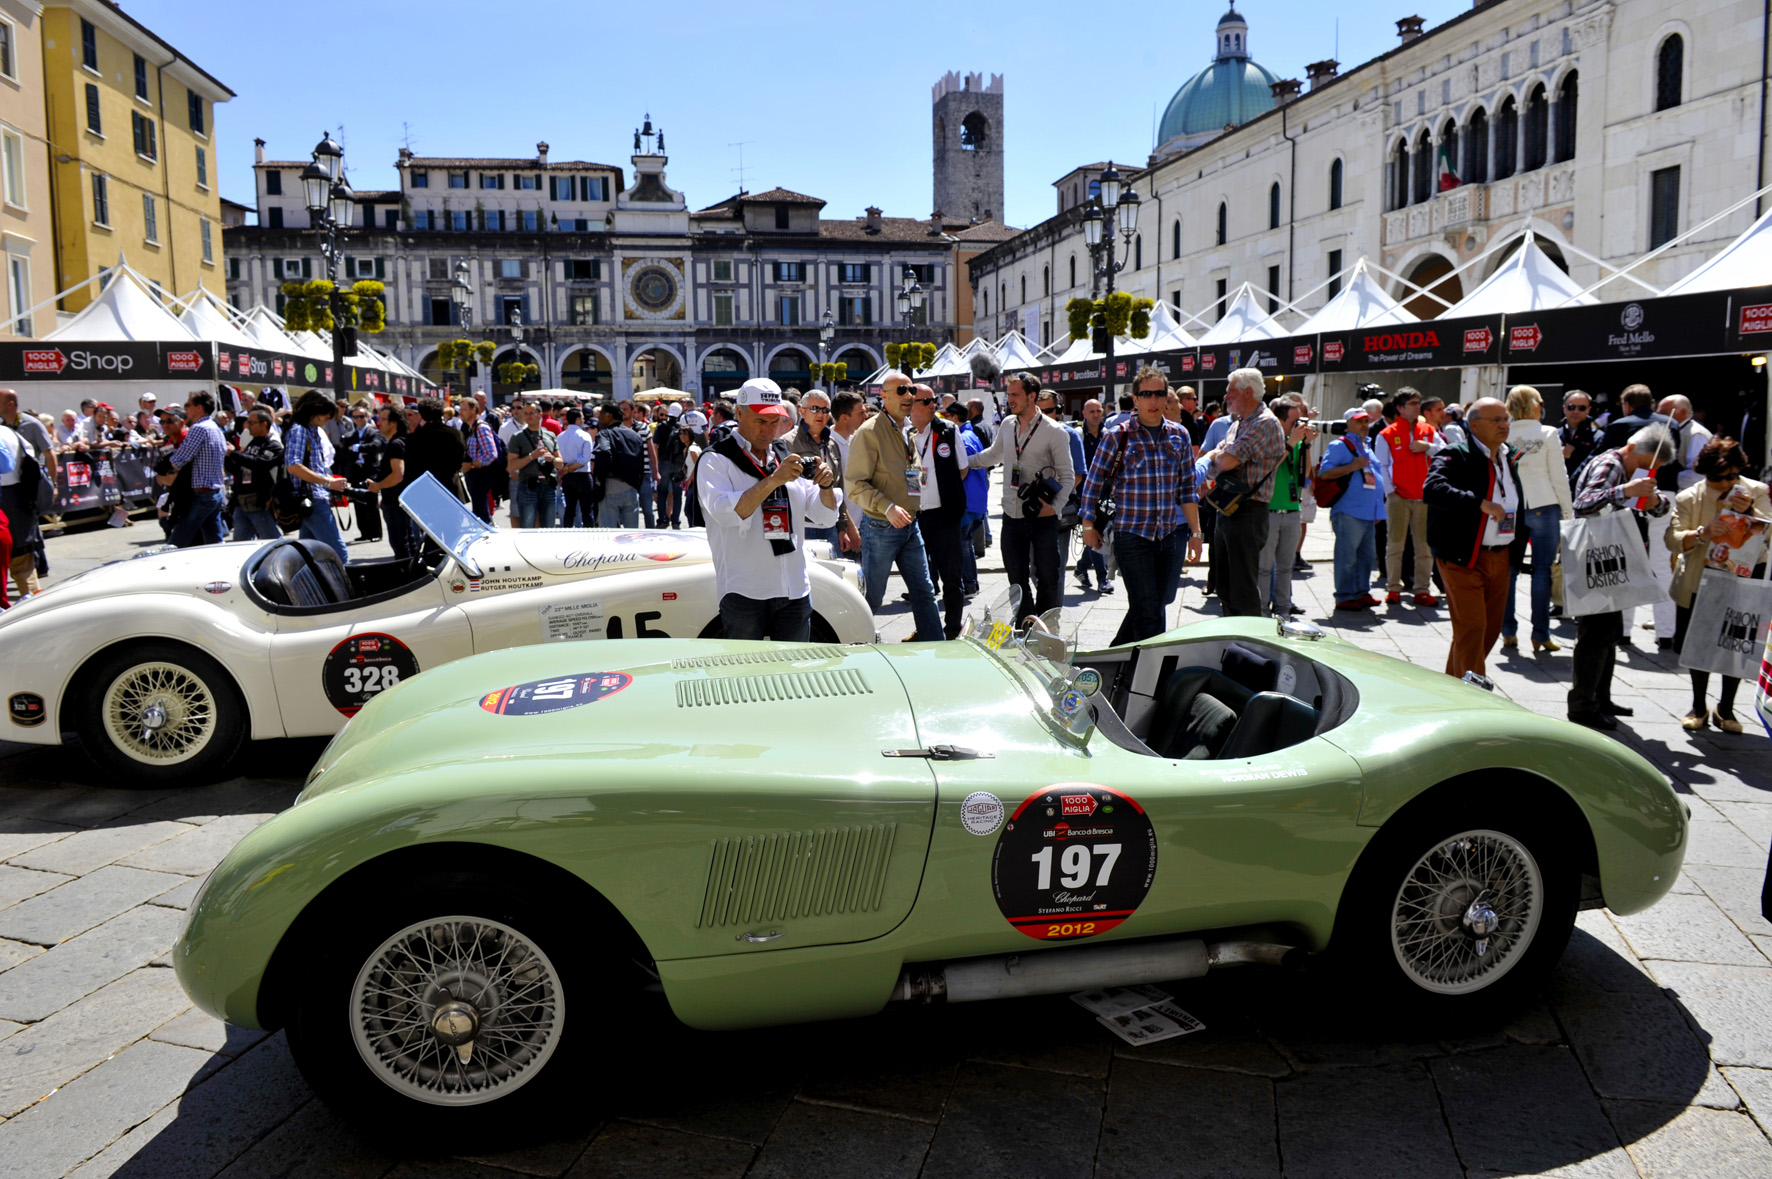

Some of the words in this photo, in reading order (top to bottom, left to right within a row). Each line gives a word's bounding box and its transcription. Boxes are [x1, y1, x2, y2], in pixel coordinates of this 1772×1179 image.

[1742, 319, 1772, 331] MIGLI
[1467, 331, 1486, 340] 1000
[1514, 329, 1534, 338] 1000
[1608, 332, 1628, 346] Fred
[1628, 331, 1655, 344] Mello
[1363, 331, 1441, 352] HONDA
[1465, 341, 1486, 349] MIGLIA
[1512, 338, 1535, 347] MIGLIA
[70, 351, 133, 373] Shop
[1380, 353, 1399, 361] Power
[1399, 352, 1407, 360] of
[1407, 351, 1433, 360] Dreams
[250, 356, 267, 378] Shop
[1586, 543, 1626, 562] FASHION
[1586, 569, 1630, 589] DISTRICT
[986, 620, 1012, 651] 197
[343, 665, 400, 693] 328
[531, 679, 578, 700] 197
[485, 692, 501, 706] 2012
[1221, 772, 1260, 782] NORMAN
[1271, 768, 1308, 778] DEWIS
[968, 804, 997, 814] JAGUAR
[1064, 805, 1090, 813] MIGLIA
[1043, 830, 1056, 838] UBI
[1092, 827, 1114, 835] Brescia
[1031, 843, 1122, 890] 197
[1052, 890, 1097, 905] Chopard
[1047, 922, 1095, 937] 2012
